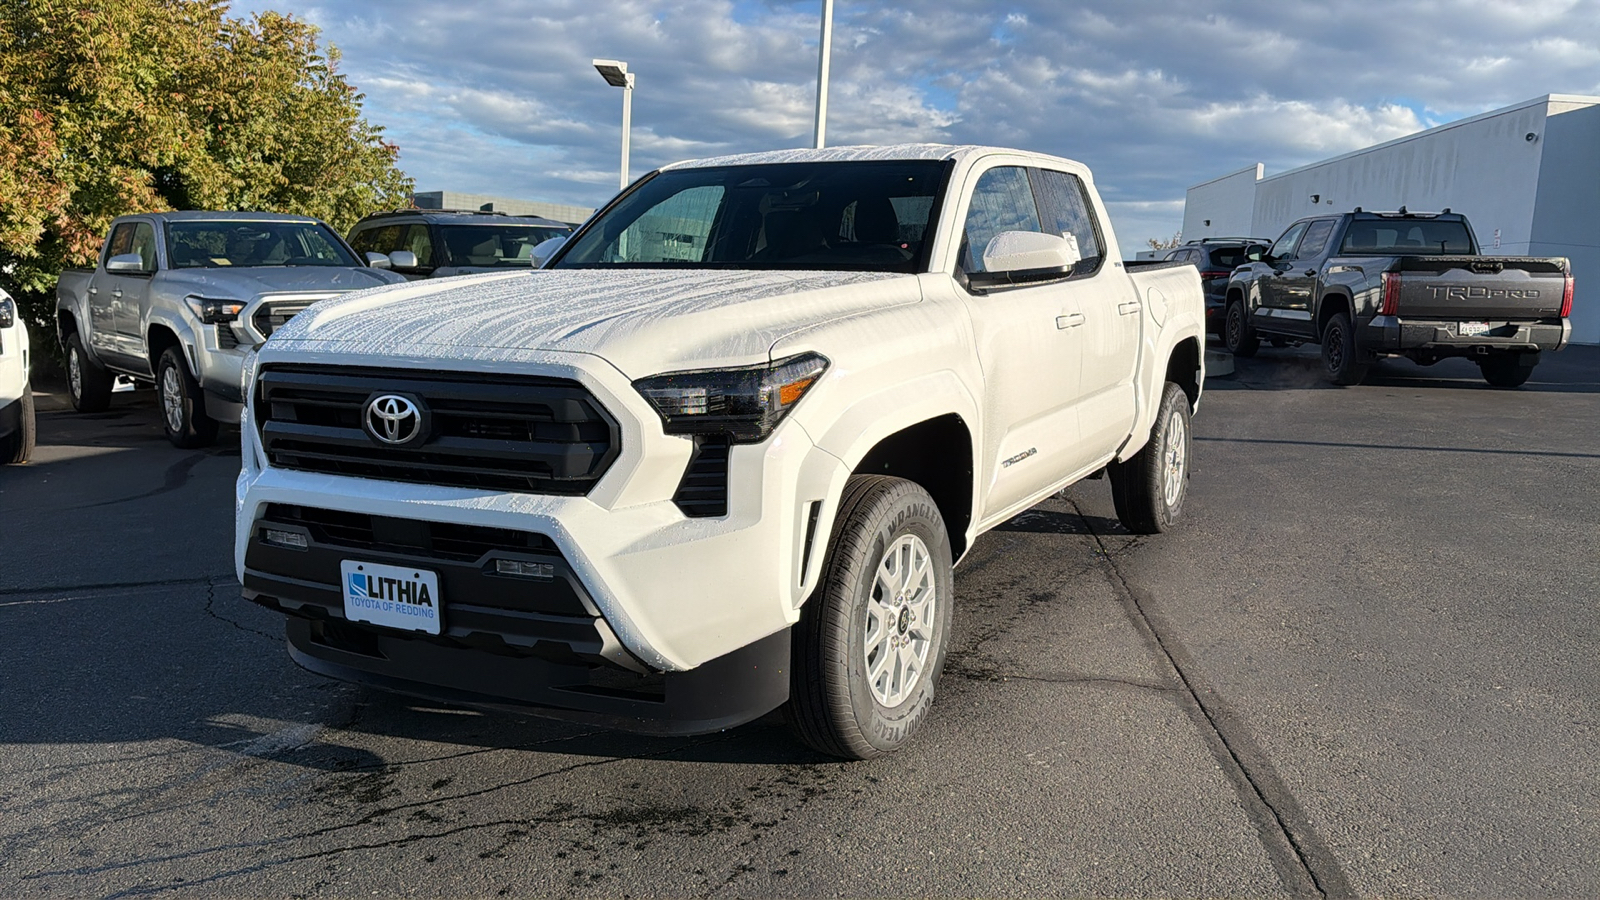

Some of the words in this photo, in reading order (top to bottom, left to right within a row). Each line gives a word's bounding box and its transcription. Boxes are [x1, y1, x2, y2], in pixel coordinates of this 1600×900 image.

[1426, 285, 1487, 301] TRD
[1487, 289, 1541, 299] PRO
[887, 503, 941, 537] WRANGLER
[367, 575, 433, 607] LITHIA
[350, 596, 381, 610] TOYOTA
[382, 601, 393, 611] OF
[395, 605, 434, 619] REDDING
